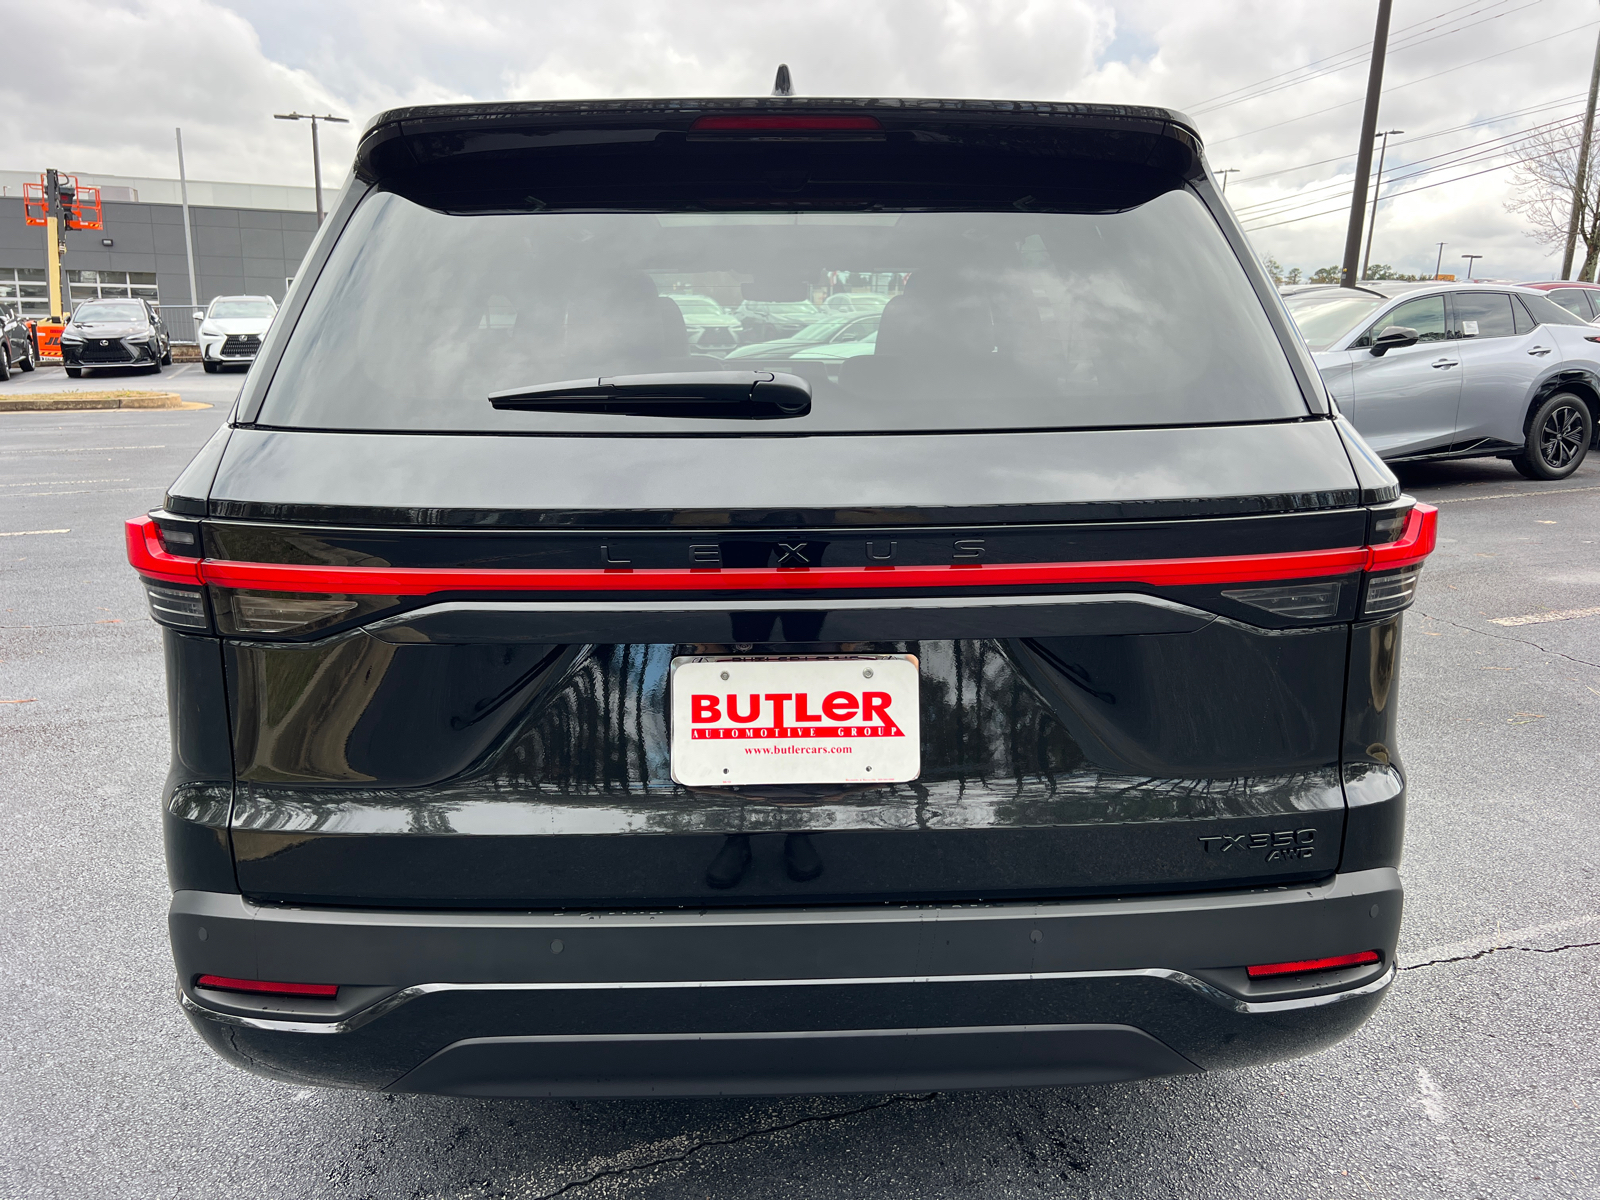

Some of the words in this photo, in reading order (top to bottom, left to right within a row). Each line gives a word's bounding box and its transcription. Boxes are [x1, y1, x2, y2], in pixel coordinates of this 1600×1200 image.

[600, 538, 987, 565] LEXUS
[692, 727, 816, 739] AUTOMOTIVE
[837, 726, 898, 737] GROUP
[744, 744, 853, 755] www.butlercars.com
[1265, 846, 1315, 862] AWD
